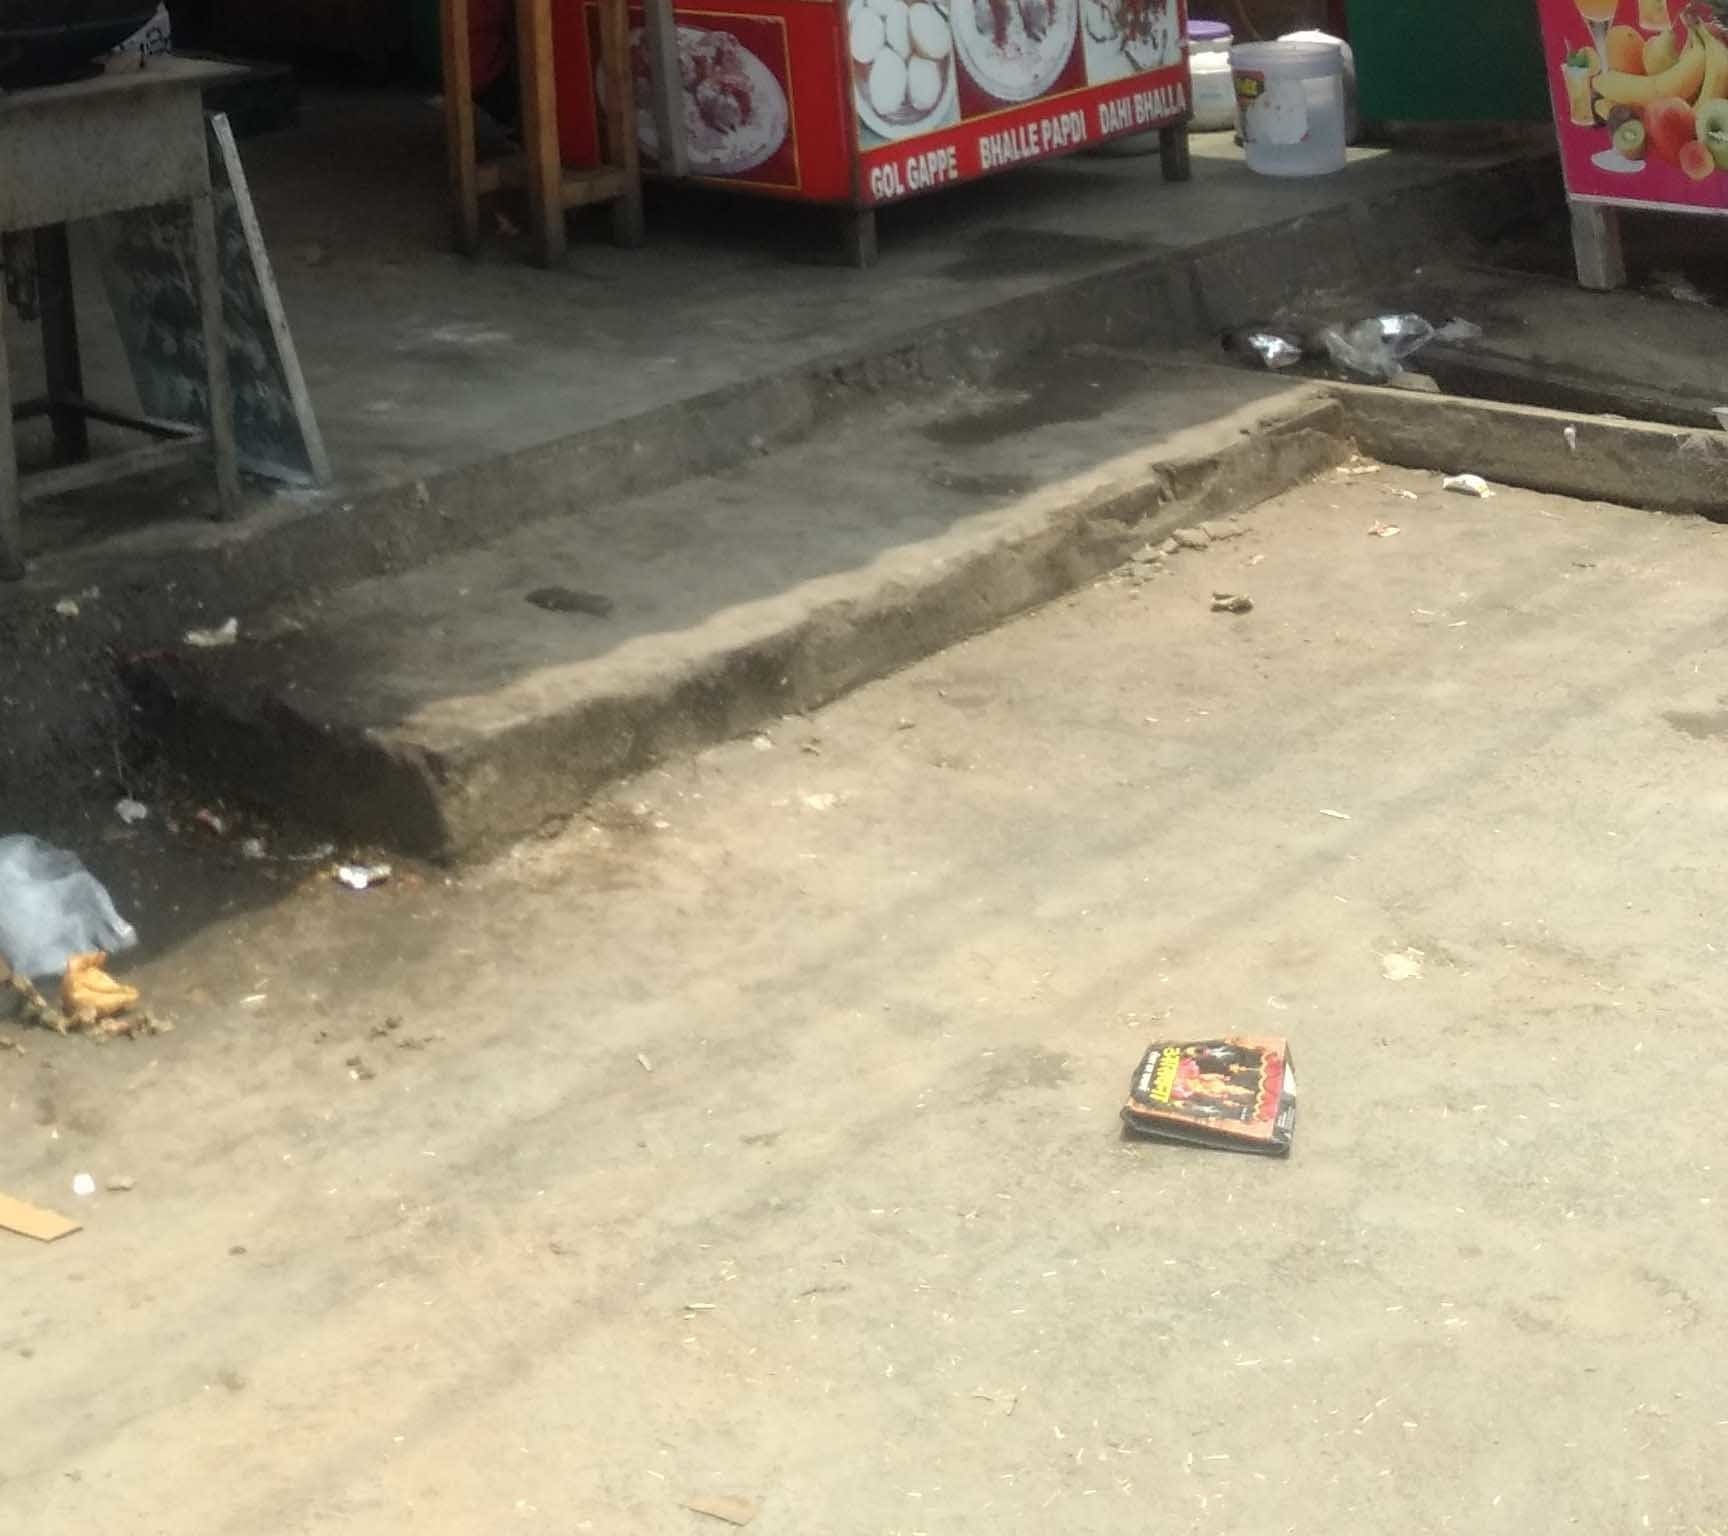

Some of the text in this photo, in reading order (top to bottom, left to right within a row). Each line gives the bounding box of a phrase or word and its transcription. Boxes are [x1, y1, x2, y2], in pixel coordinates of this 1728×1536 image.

[870, 82, 1188, 200] GOL GAPPE BHALLE PAPDI DAHI BHALLA
